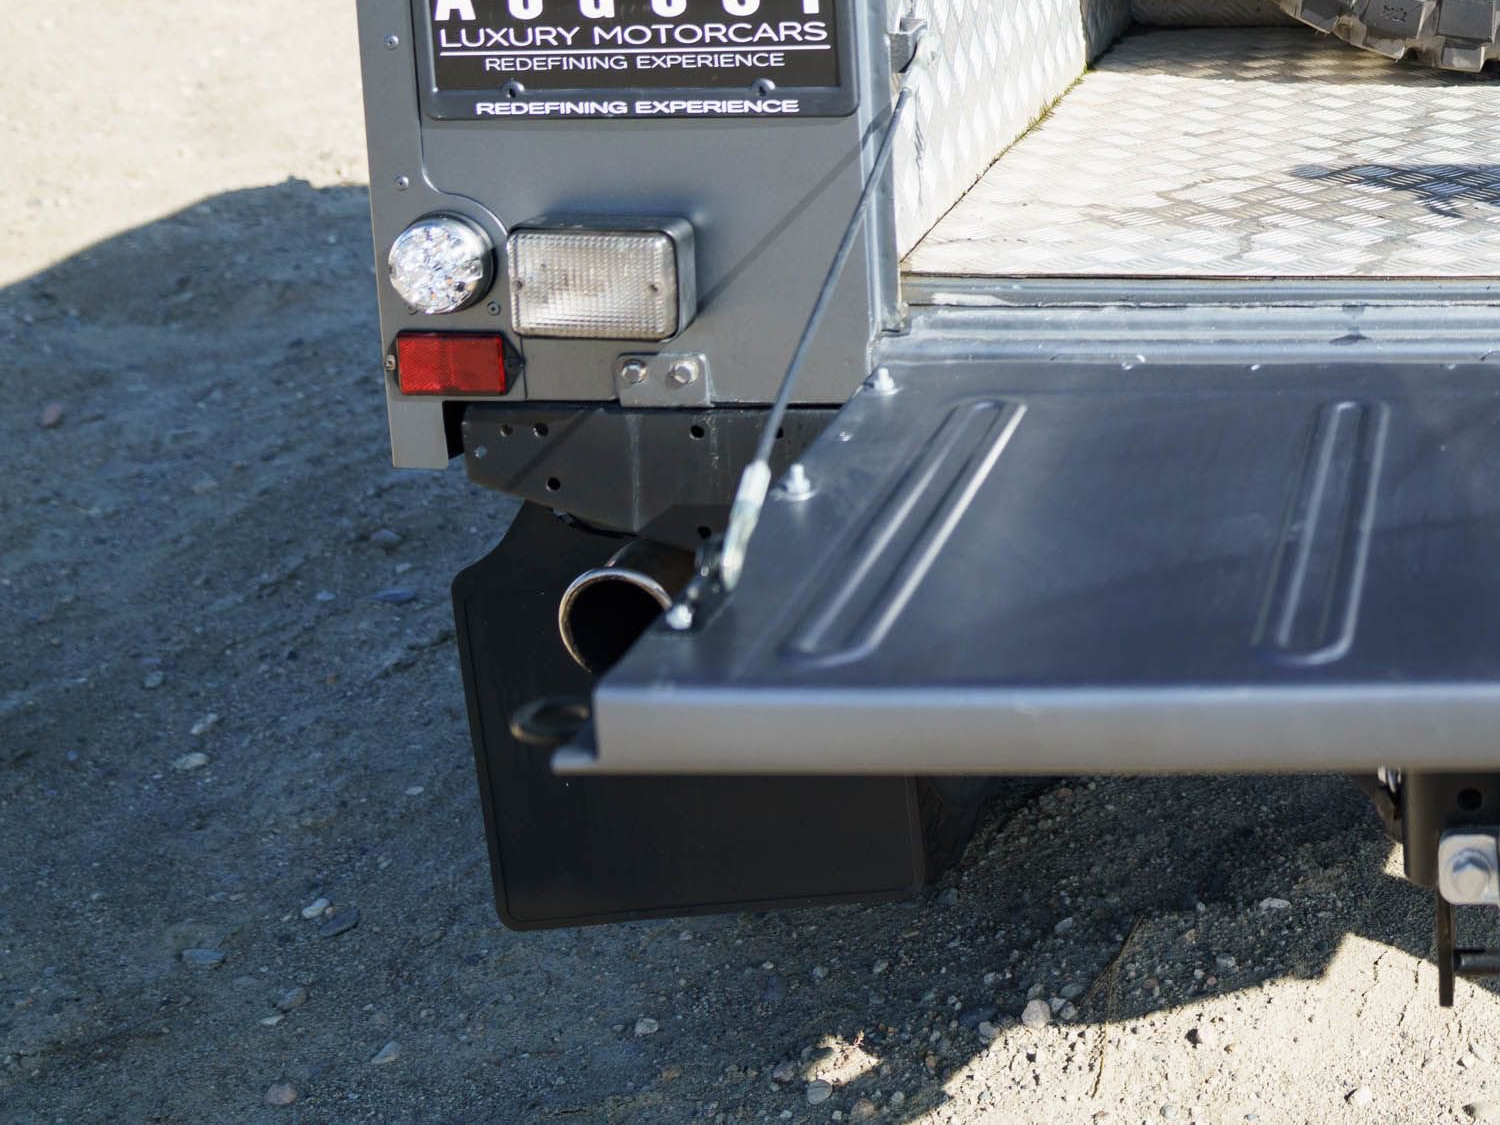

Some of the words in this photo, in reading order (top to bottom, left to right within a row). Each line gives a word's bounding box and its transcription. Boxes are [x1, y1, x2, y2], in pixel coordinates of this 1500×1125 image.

[440, 26, 580, 48] LUXURY
[593, 21, 828, 46] MOTORCARS
[485, 55, 628, 71] REDEFINING
[636, 53, 785, 70] EXPERIENCE
[476, 101, 628, 116] REDEFINING
[635, 100, 799, 115] EXPERIENCE
